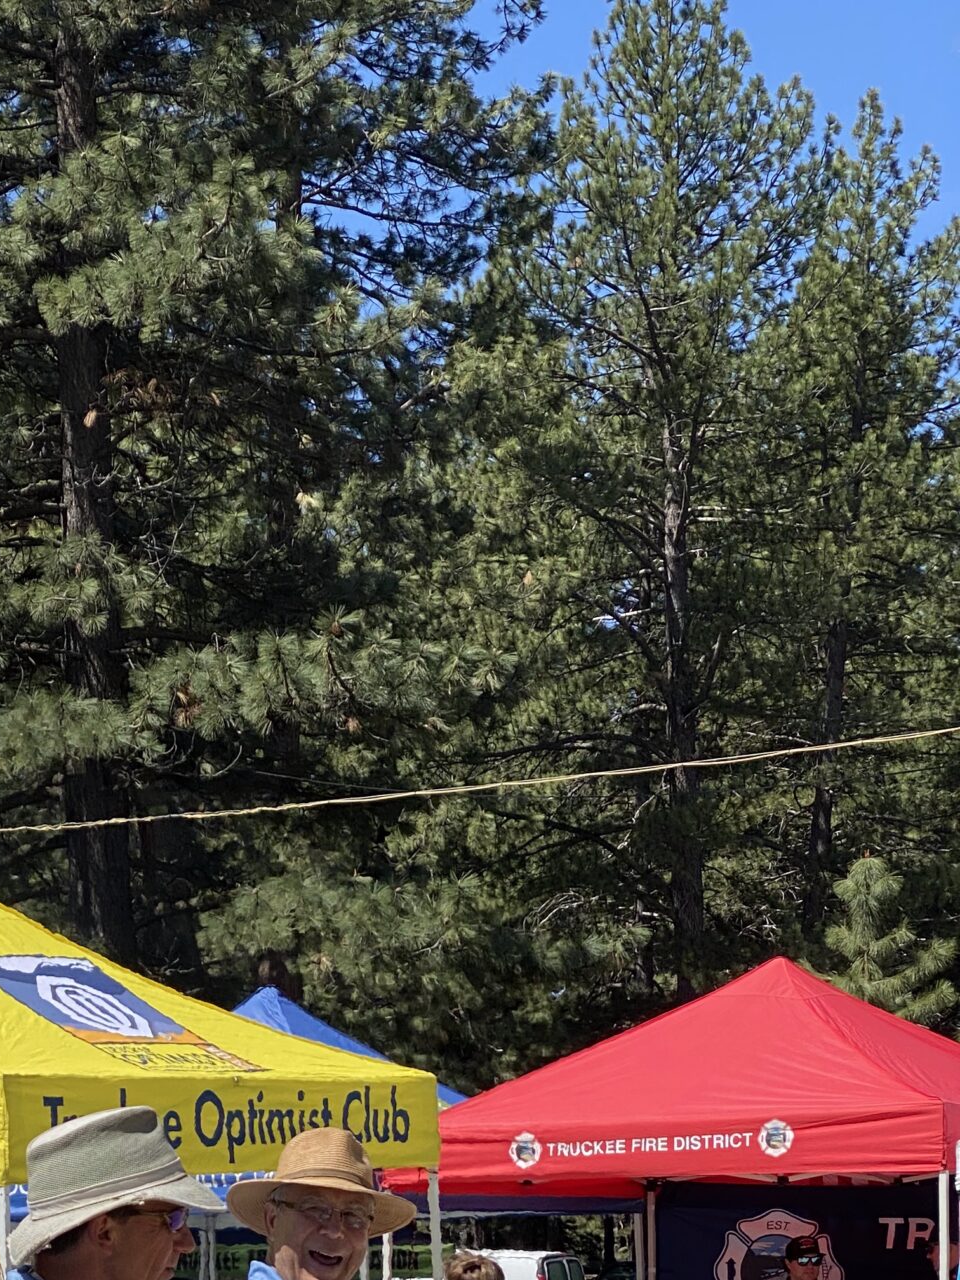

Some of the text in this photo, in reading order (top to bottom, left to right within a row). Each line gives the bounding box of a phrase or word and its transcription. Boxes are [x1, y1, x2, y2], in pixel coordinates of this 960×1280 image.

[343, 1085, 410, 1143] Club
[547, 1132, 754, 1157] TRUCKEE FIRE DISTRICT
[766, 1220, 790, 1232] EST.
